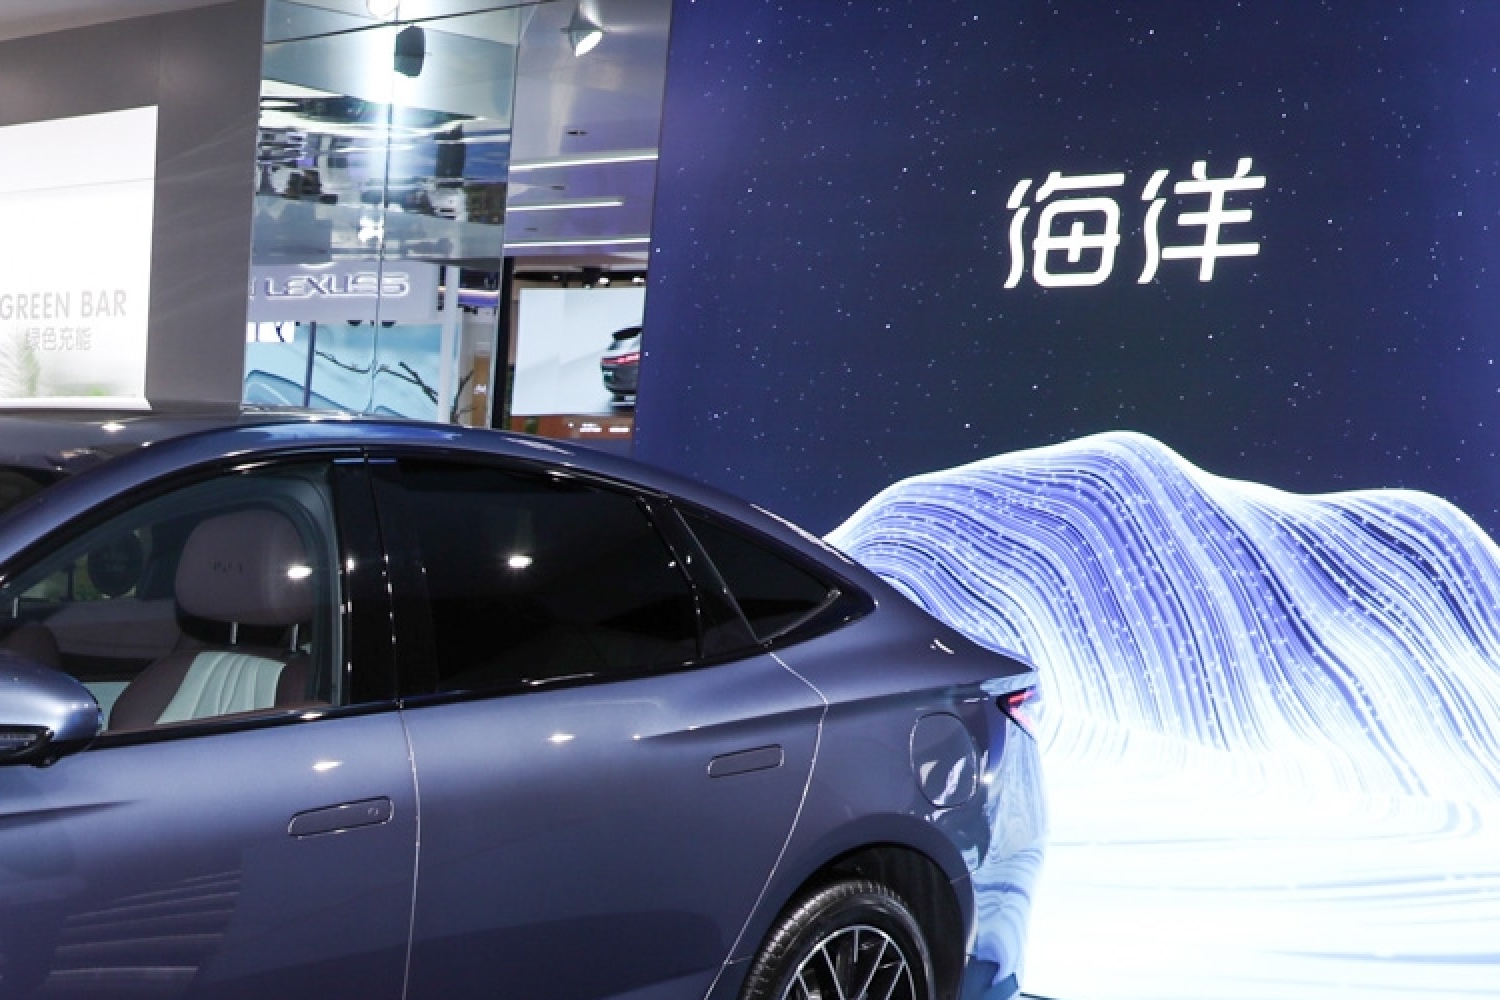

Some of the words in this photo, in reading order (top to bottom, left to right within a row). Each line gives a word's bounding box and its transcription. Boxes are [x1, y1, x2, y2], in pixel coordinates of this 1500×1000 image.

[1003, 157, 1266, 288] 海洋
[81, 289, 127, 318] BAR
[24, 326, 92, 351] 绿色充能
